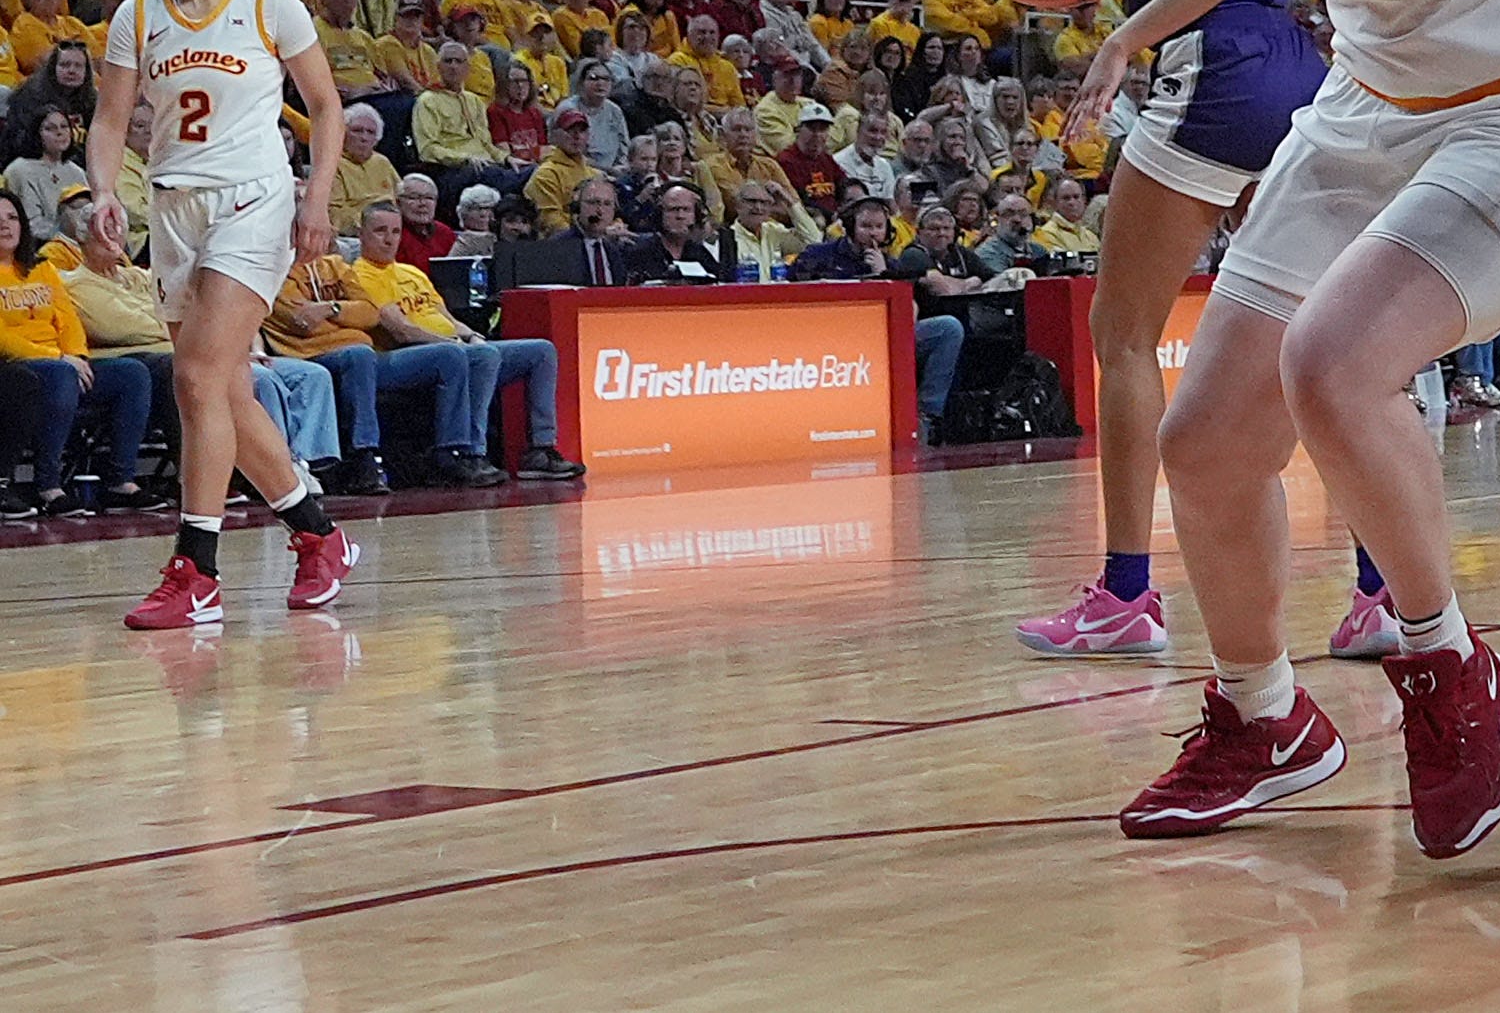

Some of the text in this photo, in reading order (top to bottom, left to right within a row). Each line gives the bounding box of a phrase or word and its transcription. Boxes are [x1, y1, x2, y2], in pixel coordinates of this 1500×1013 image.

[149, 47, 248, 80] Cyclones
[179, 90, 211, 143] 2
[630, 353, 871, 399] First Interstate Bank
